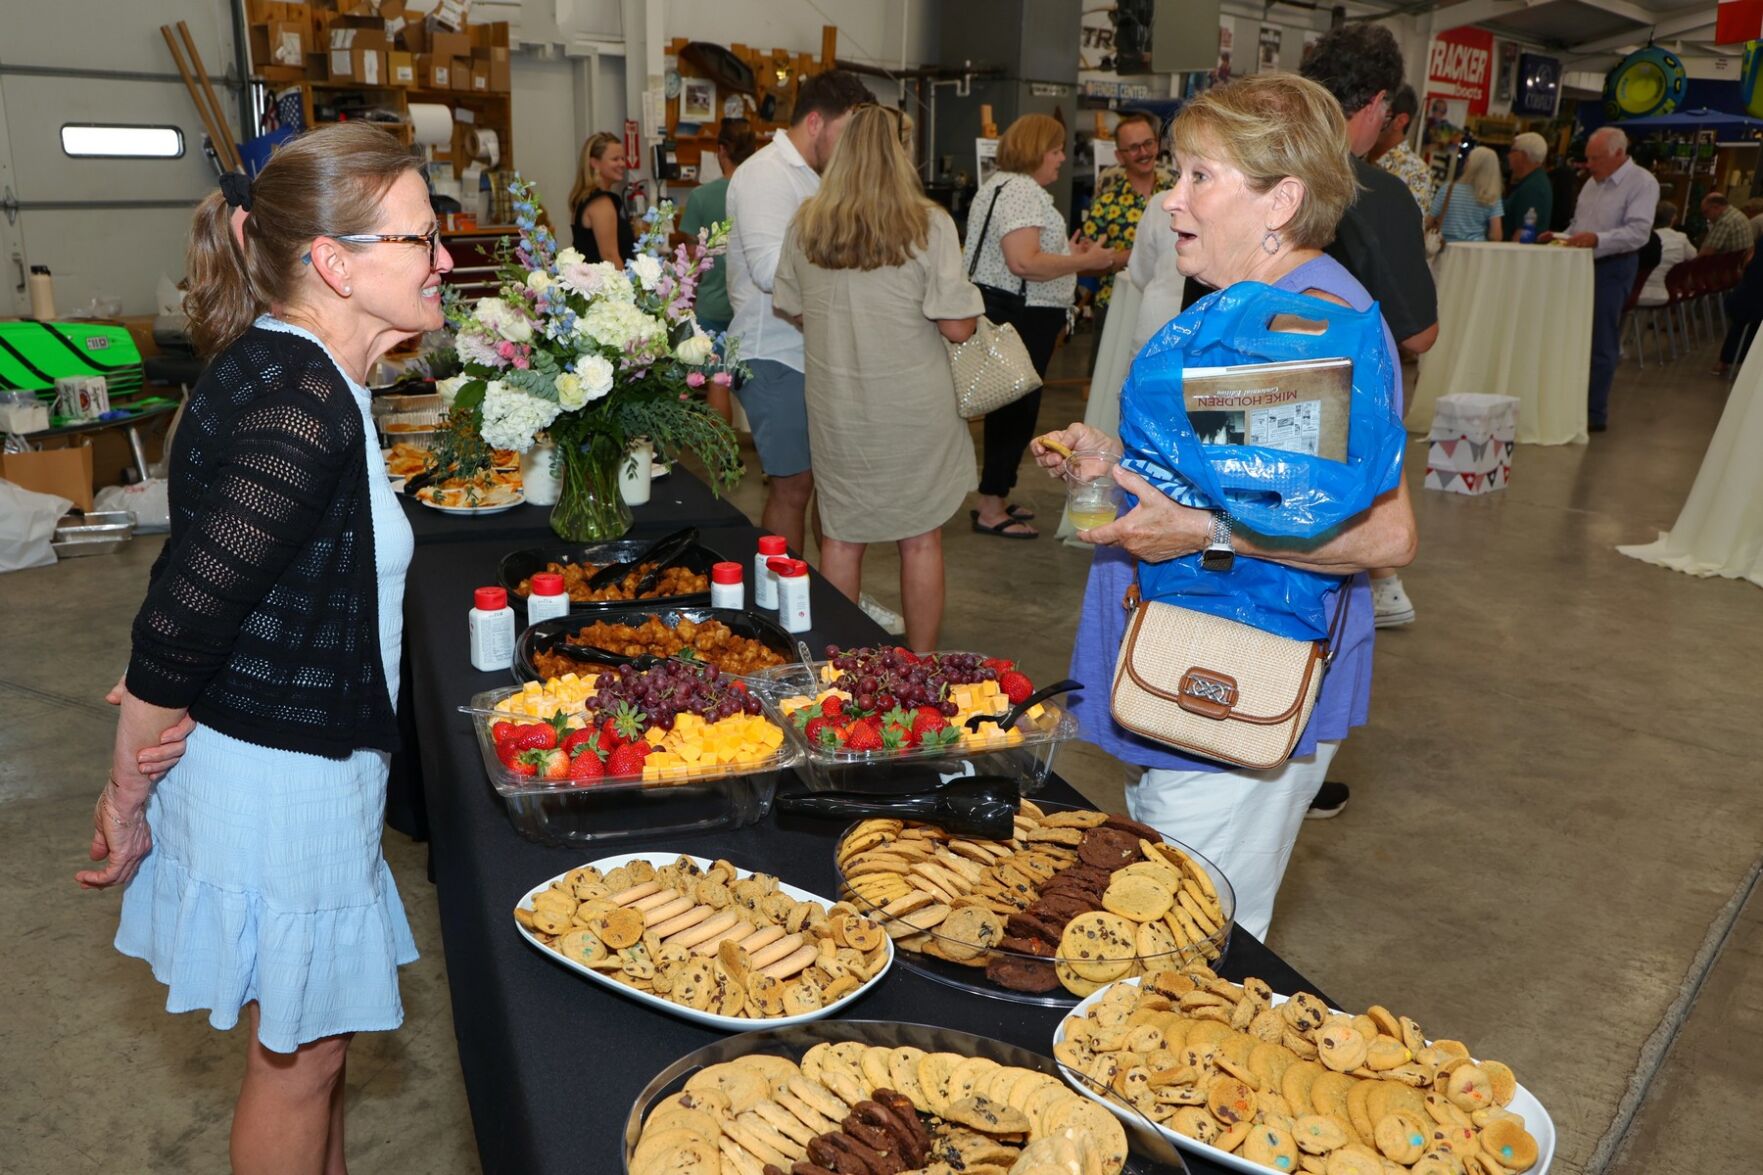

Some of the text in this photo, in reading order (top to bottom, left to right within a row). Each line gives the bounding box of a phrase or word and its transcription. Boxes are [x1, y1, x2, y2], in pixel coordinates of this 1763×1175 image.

[1083, 27, 1114, 49] TR
[1199, 390, 1297, 407] MIKE HOLDREN
